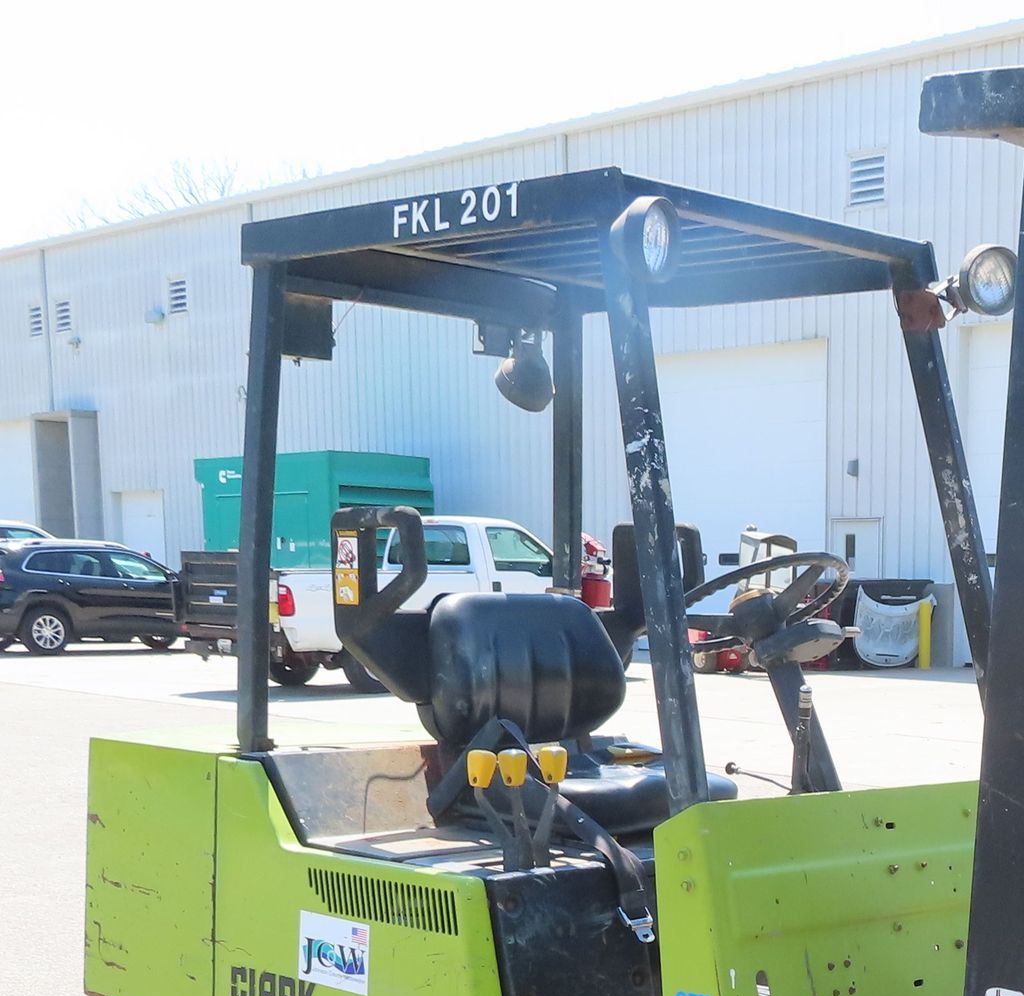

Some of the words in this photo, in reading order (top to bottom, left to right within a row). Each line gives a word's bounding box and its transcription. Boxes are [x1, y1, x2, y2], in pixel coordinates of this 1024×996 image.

[393, 197, 450, 238] FKL
[460, 182, 518, 225] 201
[302, 936, 366, 975] JCW
